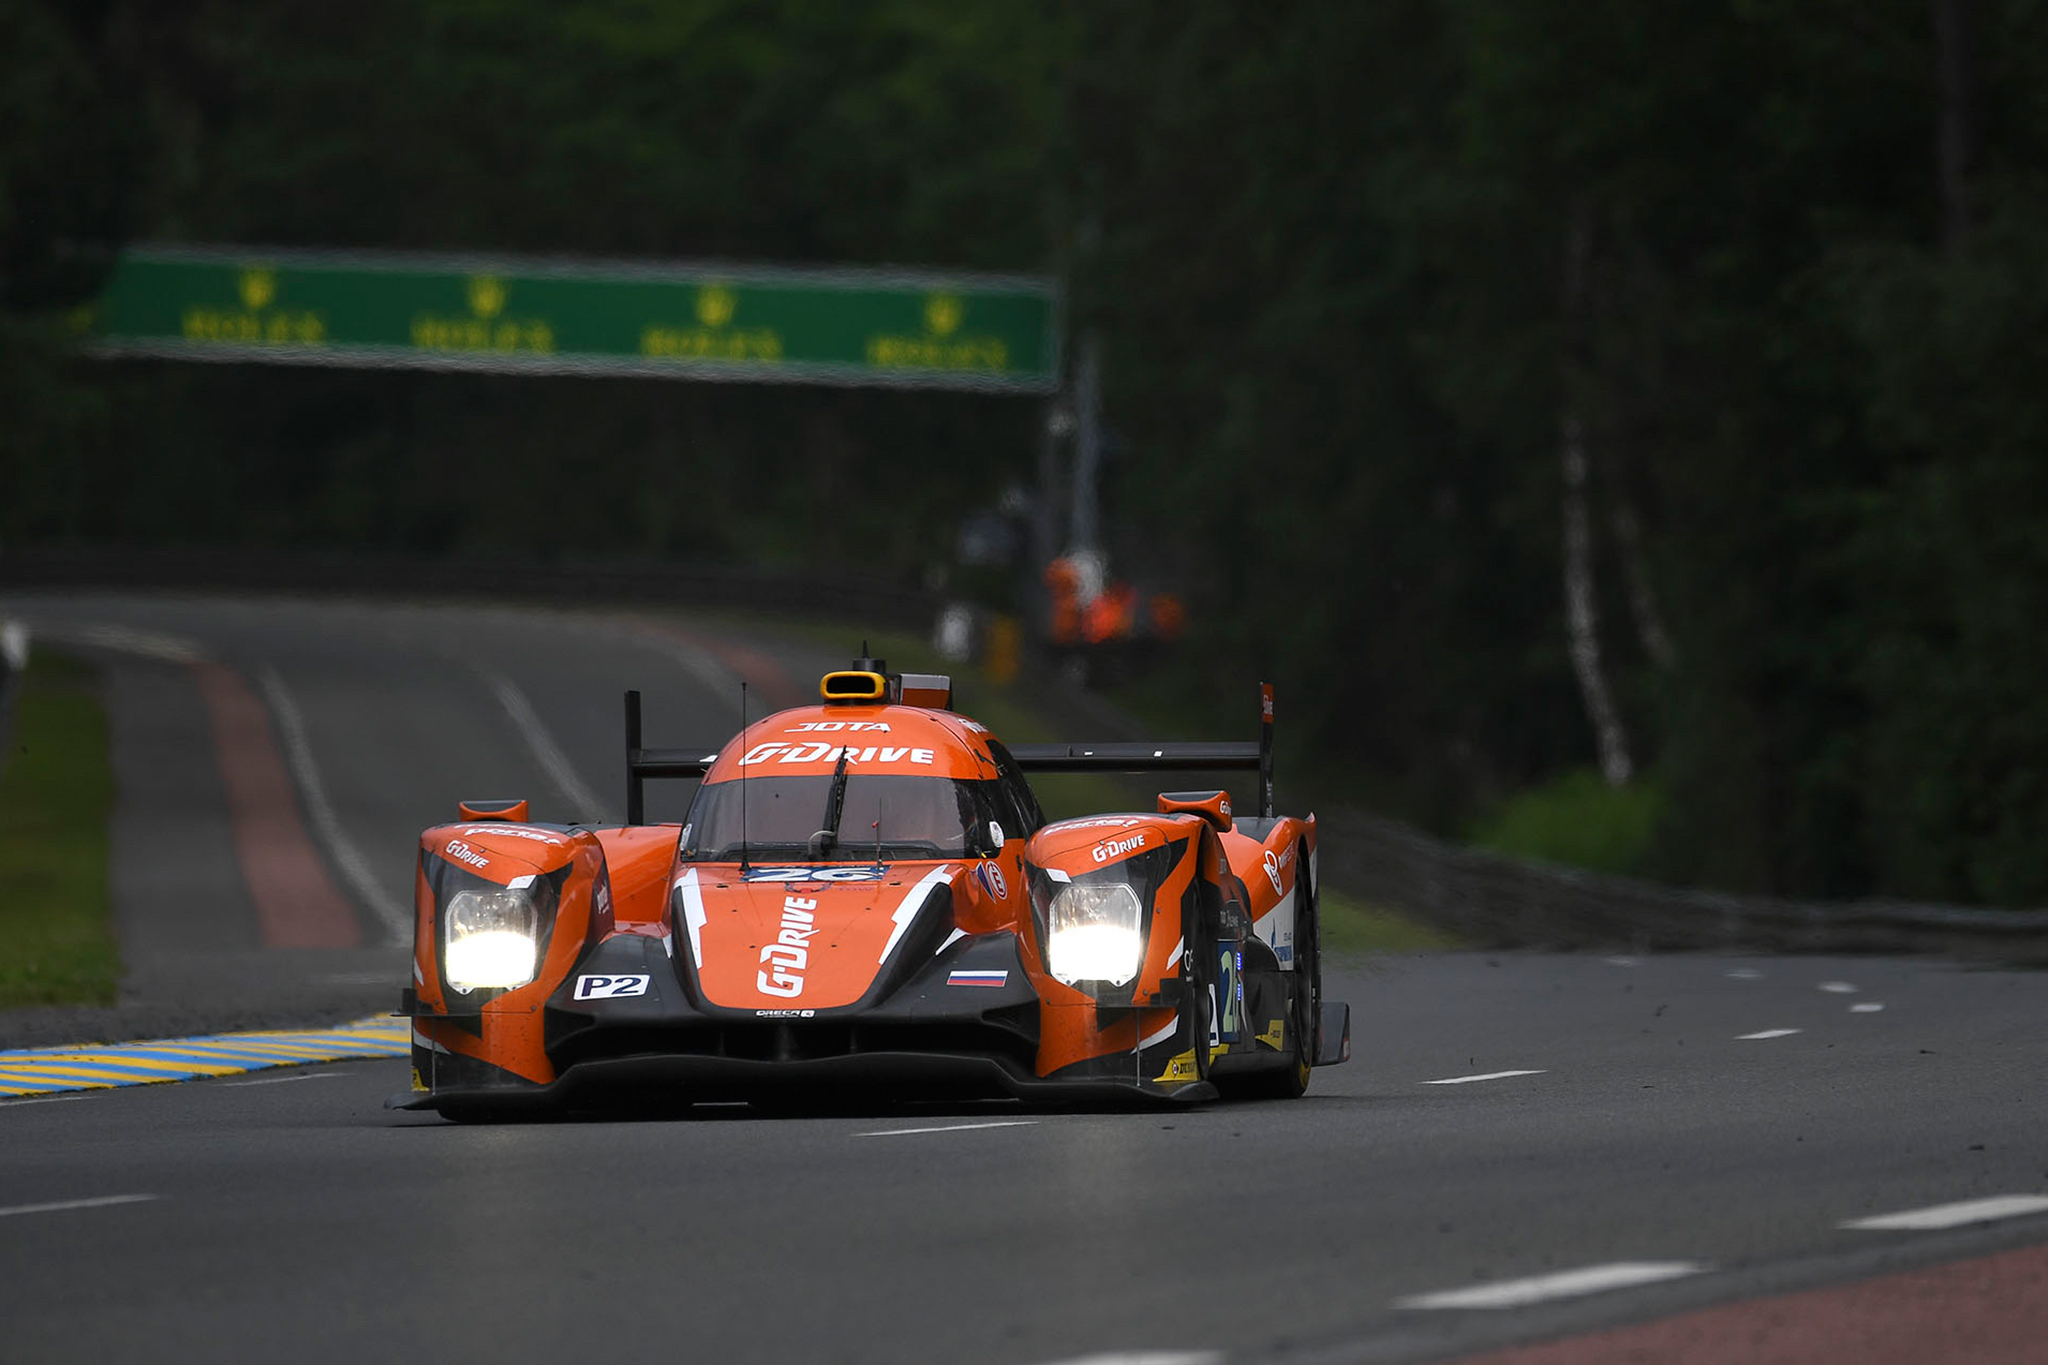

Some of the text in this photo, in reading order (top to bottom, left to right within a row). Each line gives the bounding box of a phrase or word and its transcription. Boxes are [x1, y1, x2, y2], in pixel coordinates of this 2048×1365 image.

[784, 722, 891, 733] JOTA
[749, 867, 877, 882] 26
[582, 976, 640, 997] P2
